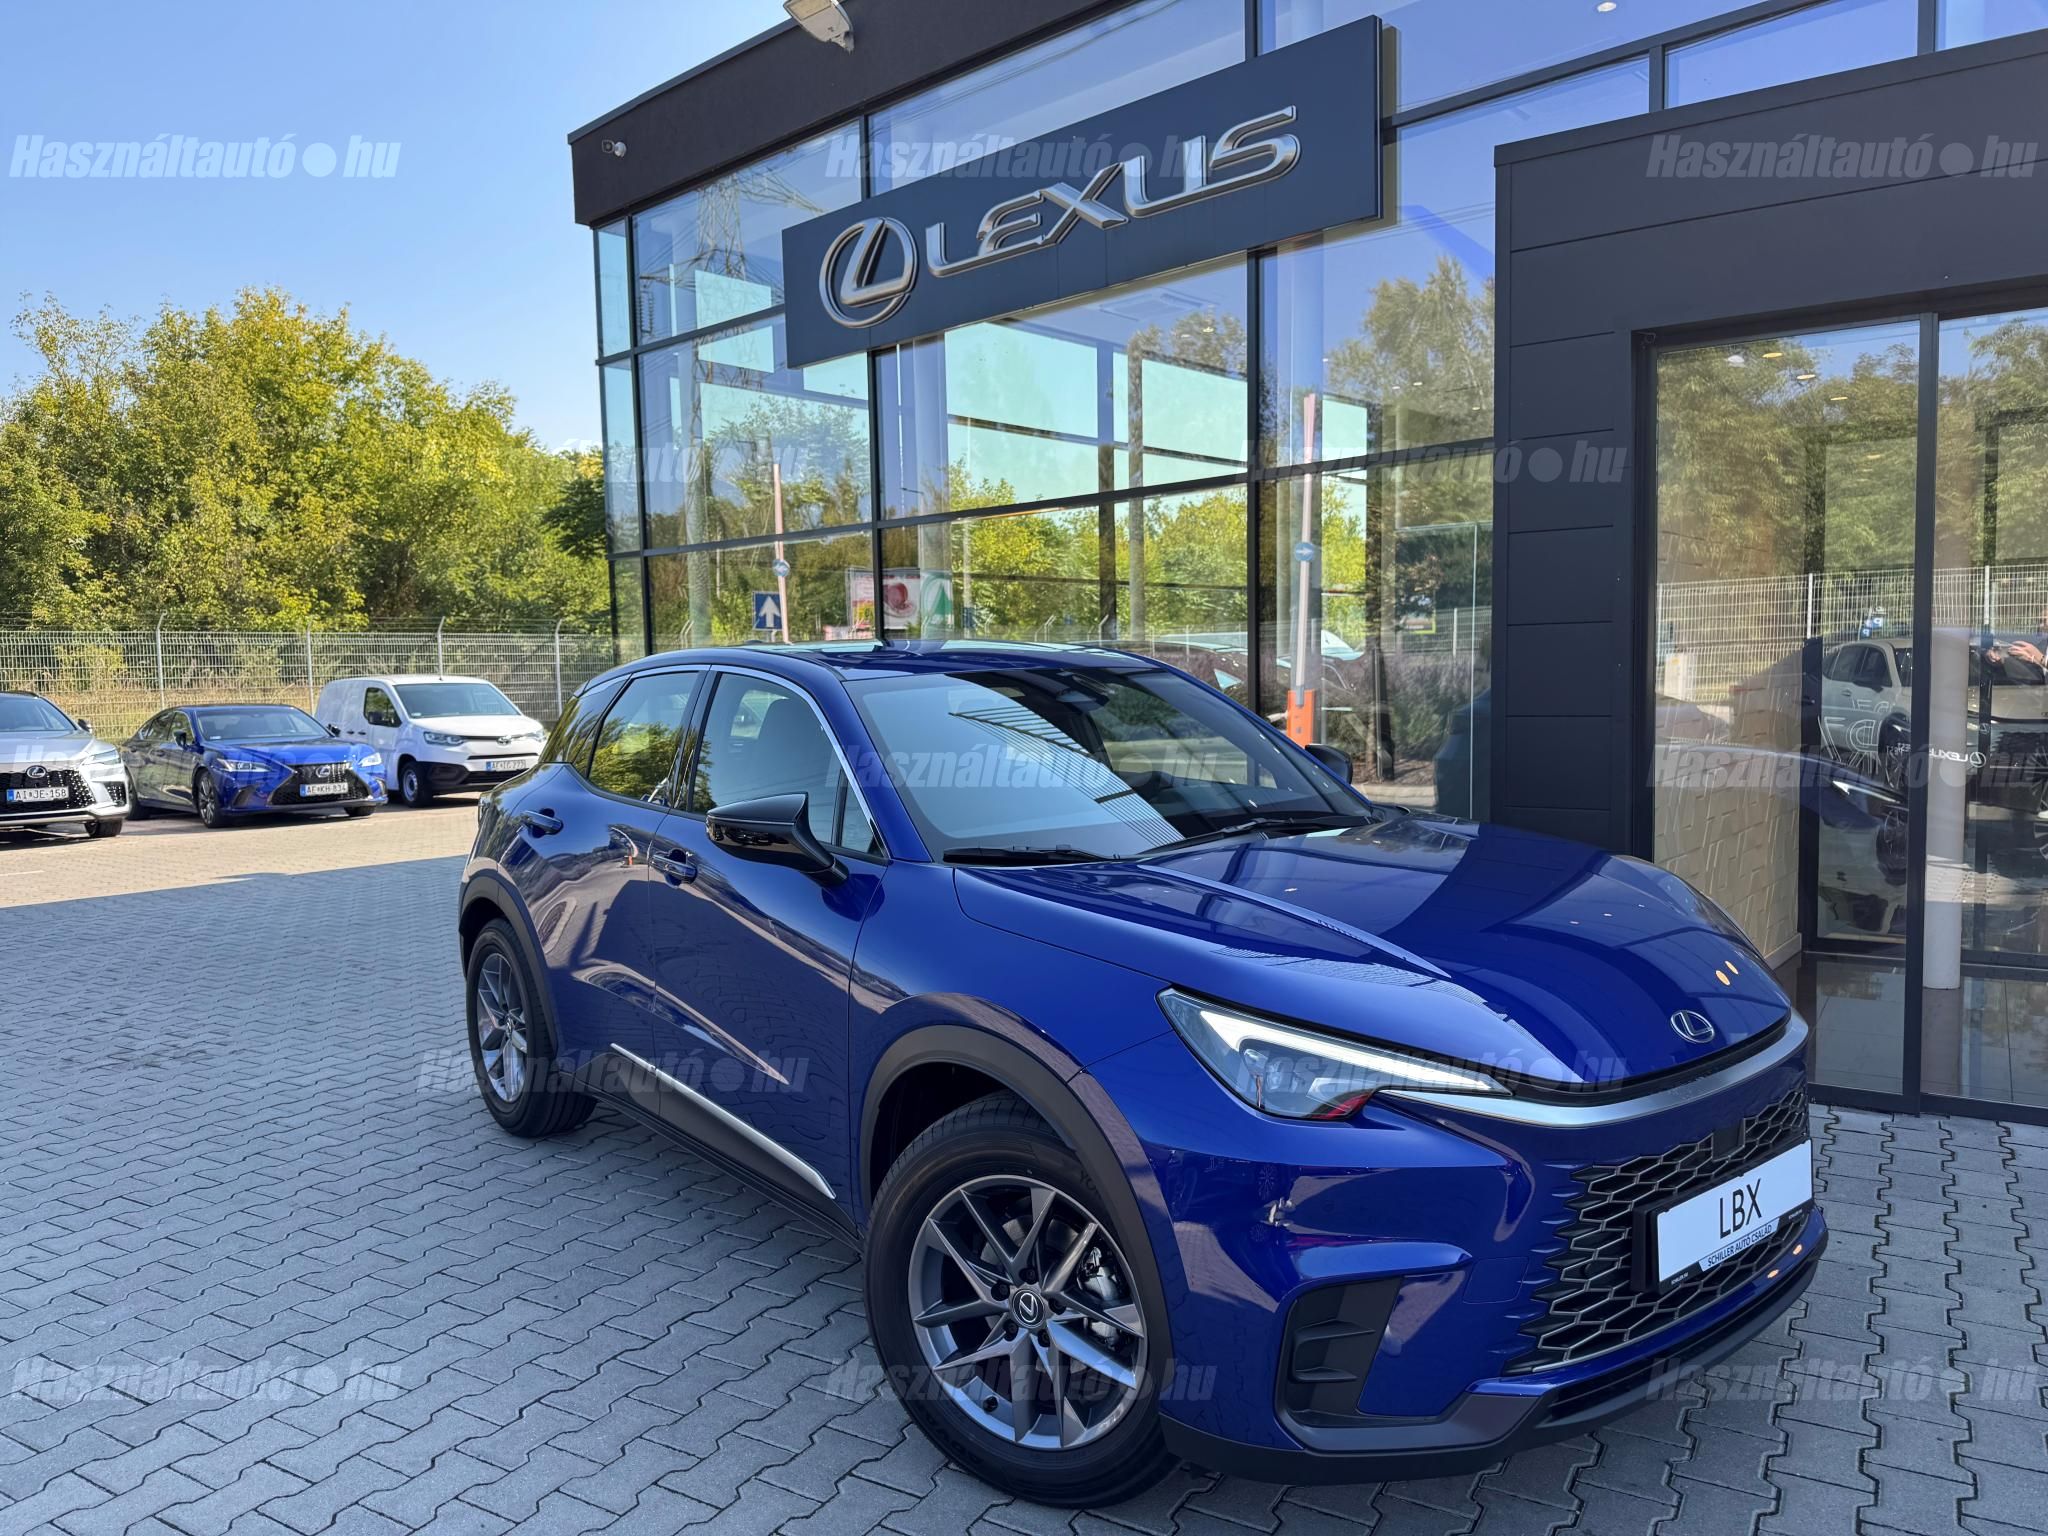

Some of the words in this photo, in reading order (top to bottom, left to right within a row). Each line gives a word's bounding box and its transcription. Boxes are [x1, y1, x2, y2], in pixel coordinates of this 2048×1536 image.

[925, 105, 1301, 277] LEXUS
[1720, 1178, 1763, 1239] LBX
[1707, 1246, 1734, 1267] SCHILLER
